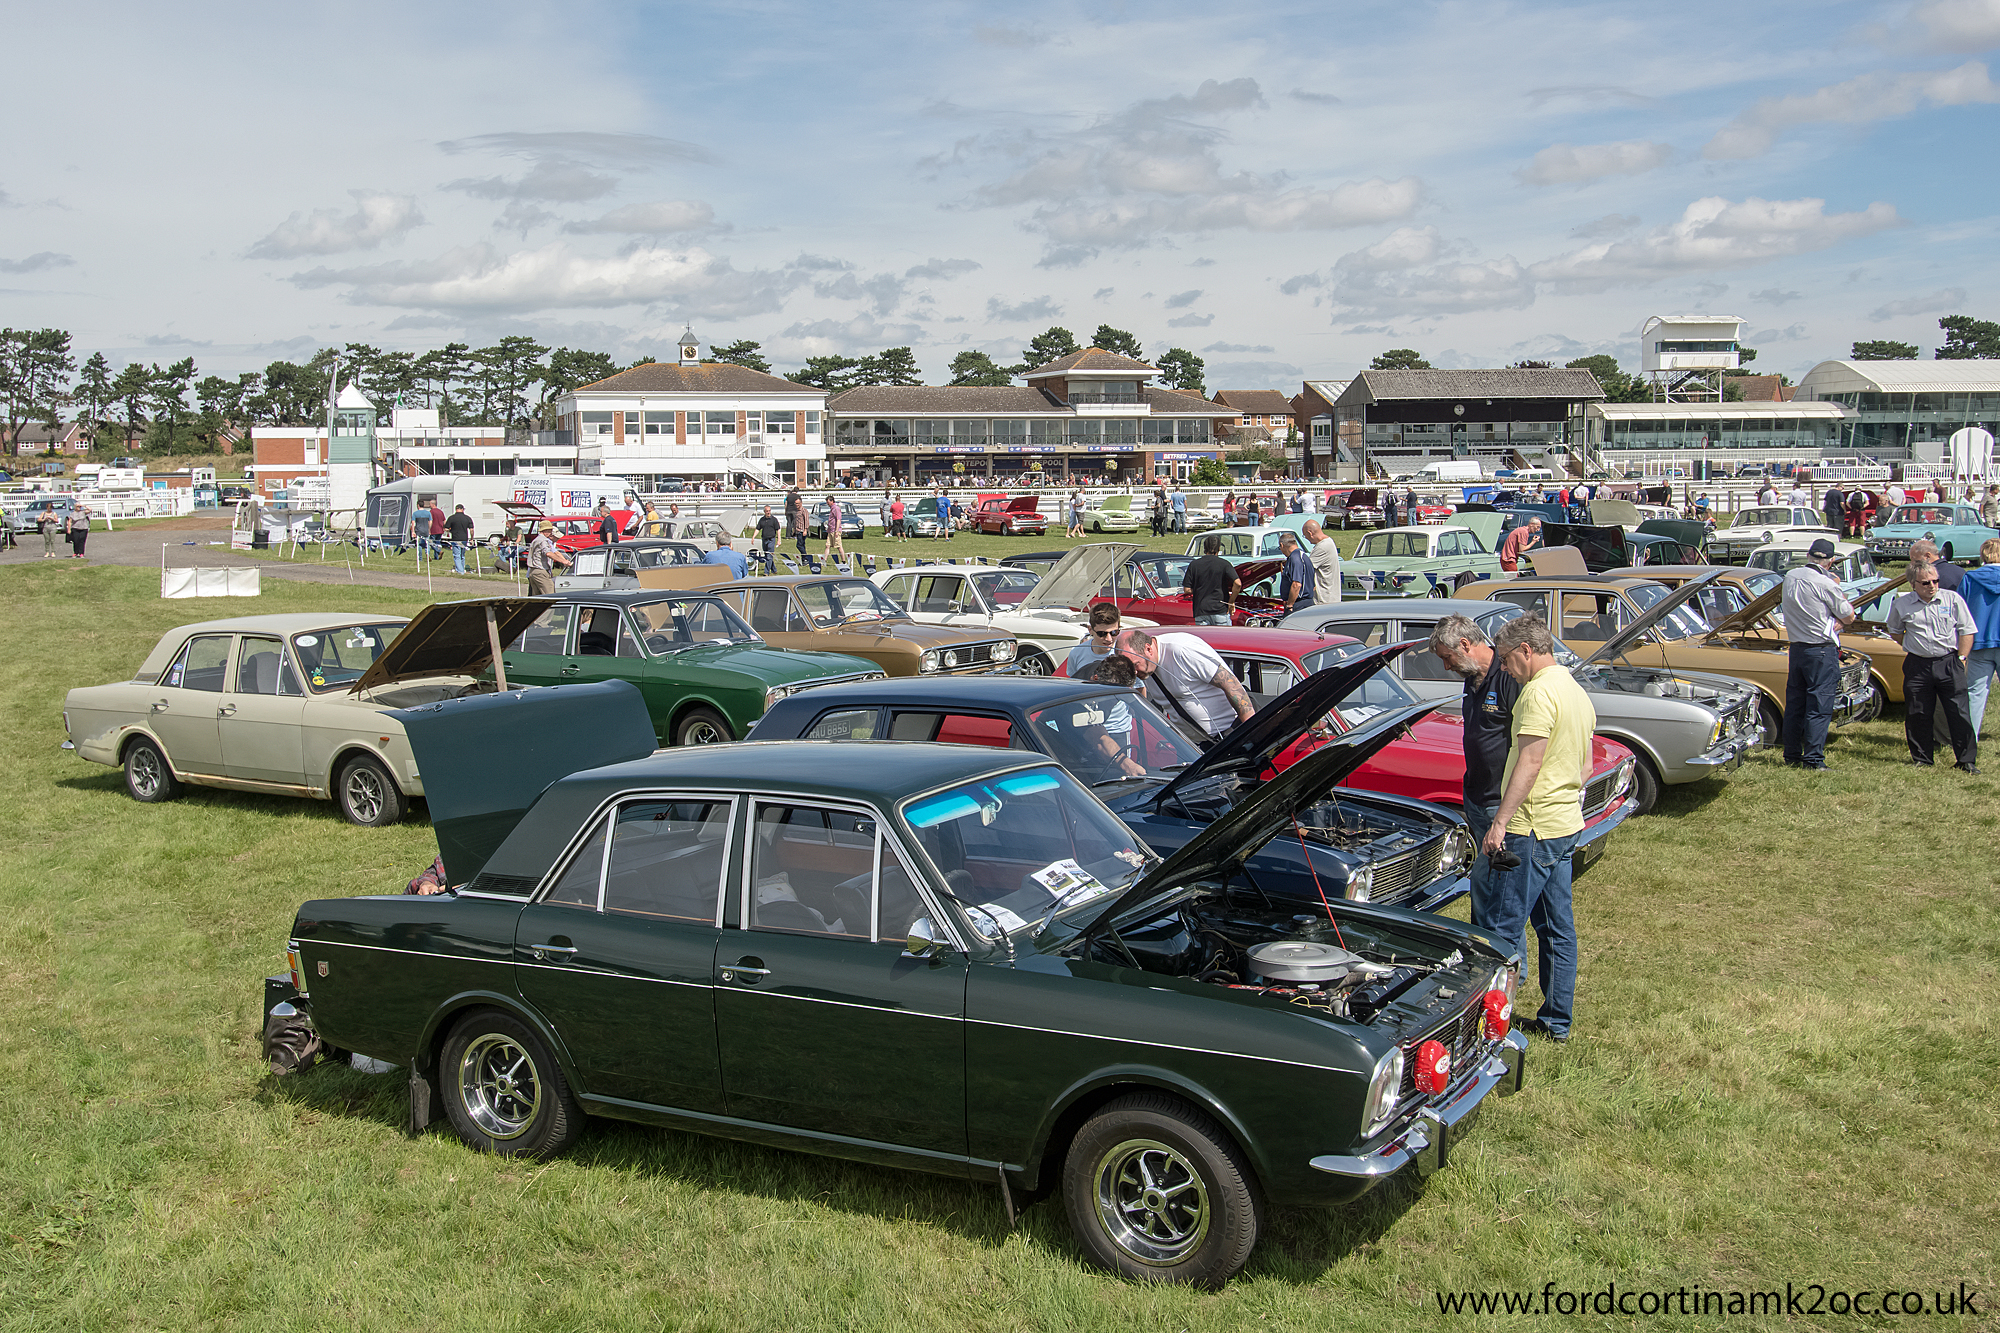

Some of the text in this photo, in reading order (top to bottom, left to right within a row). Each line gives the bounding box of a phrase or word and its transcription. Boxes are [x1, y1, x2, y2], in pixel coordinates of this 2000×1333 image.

[525, 496, 546, 505] HIRE
[561, 492, 571, 507] TJ
[572, 497, 591, 507] HIRE
[1221, 1182, 1237, 1242] AVON
